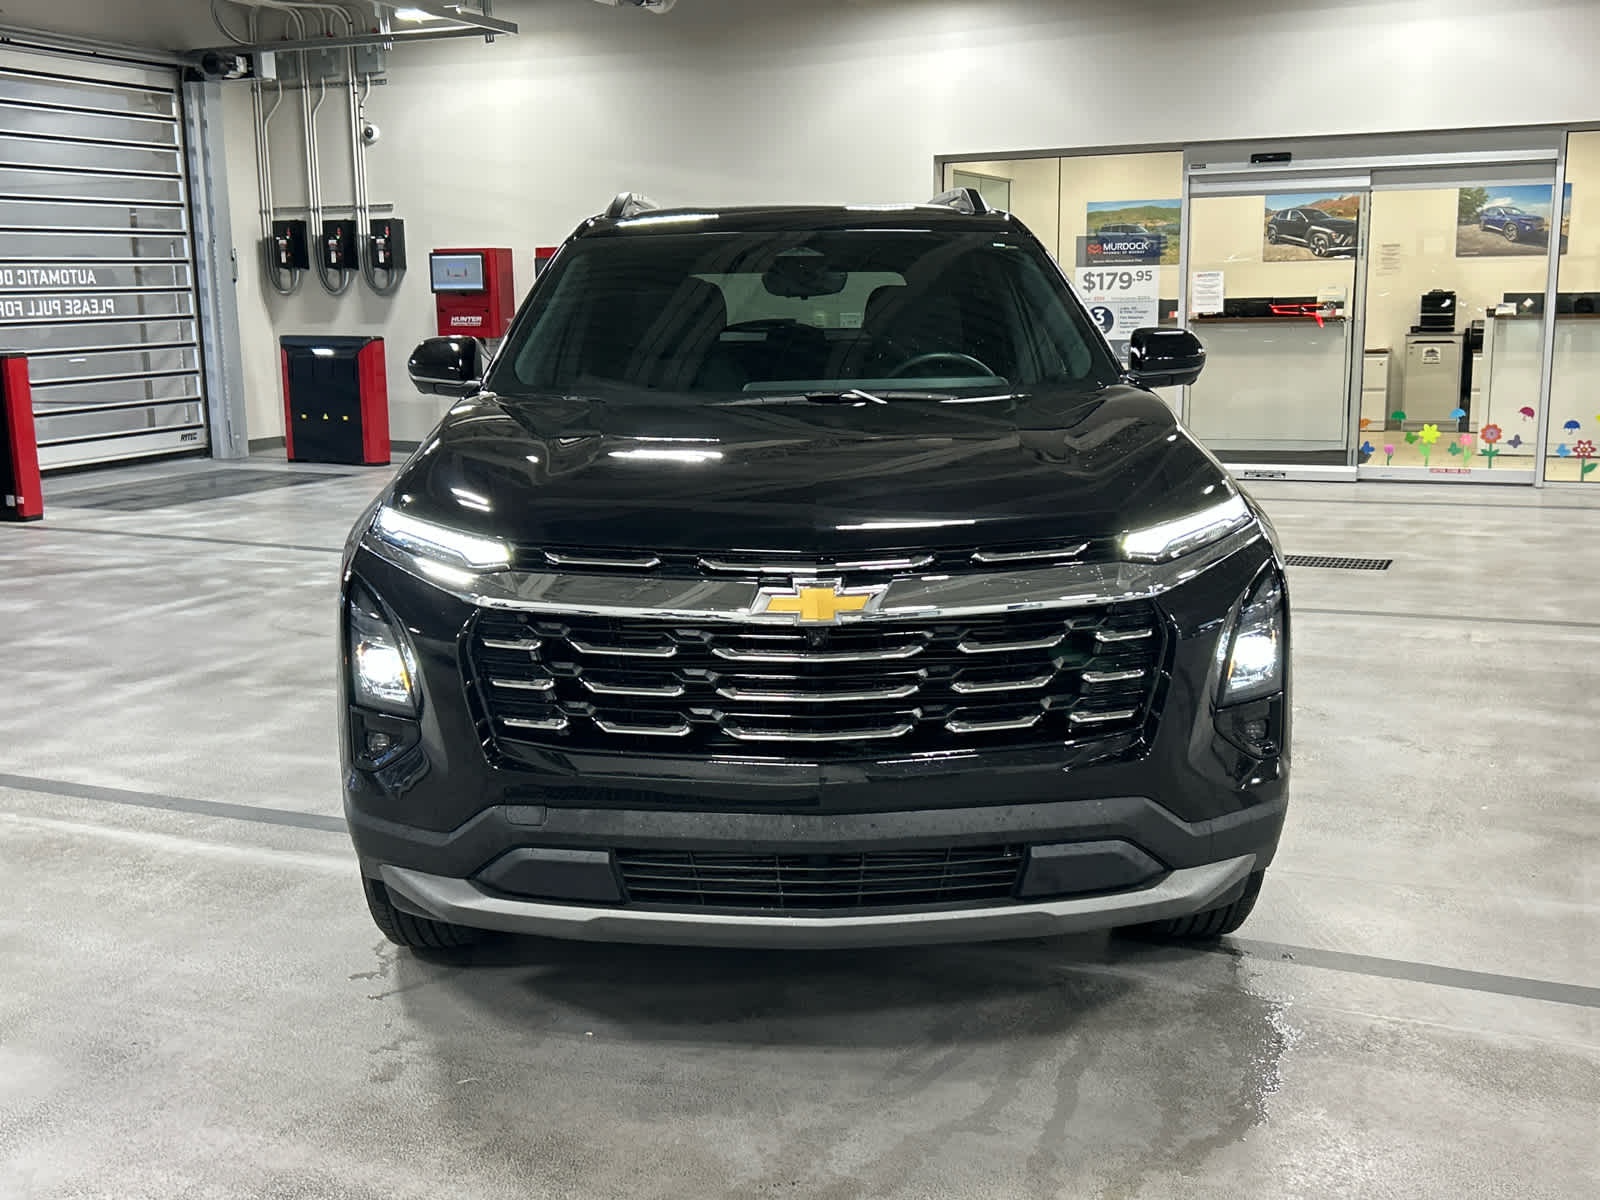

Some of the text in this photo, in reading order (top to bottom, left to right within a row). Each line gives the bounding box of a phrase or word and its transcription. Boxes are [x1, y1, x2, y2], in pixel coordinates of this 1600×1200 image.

[1103, 241, 1149, 251] MURDOCK
[451, 315, 482, 323] HUNTER
[1093, 309, 1105, 324] 3
